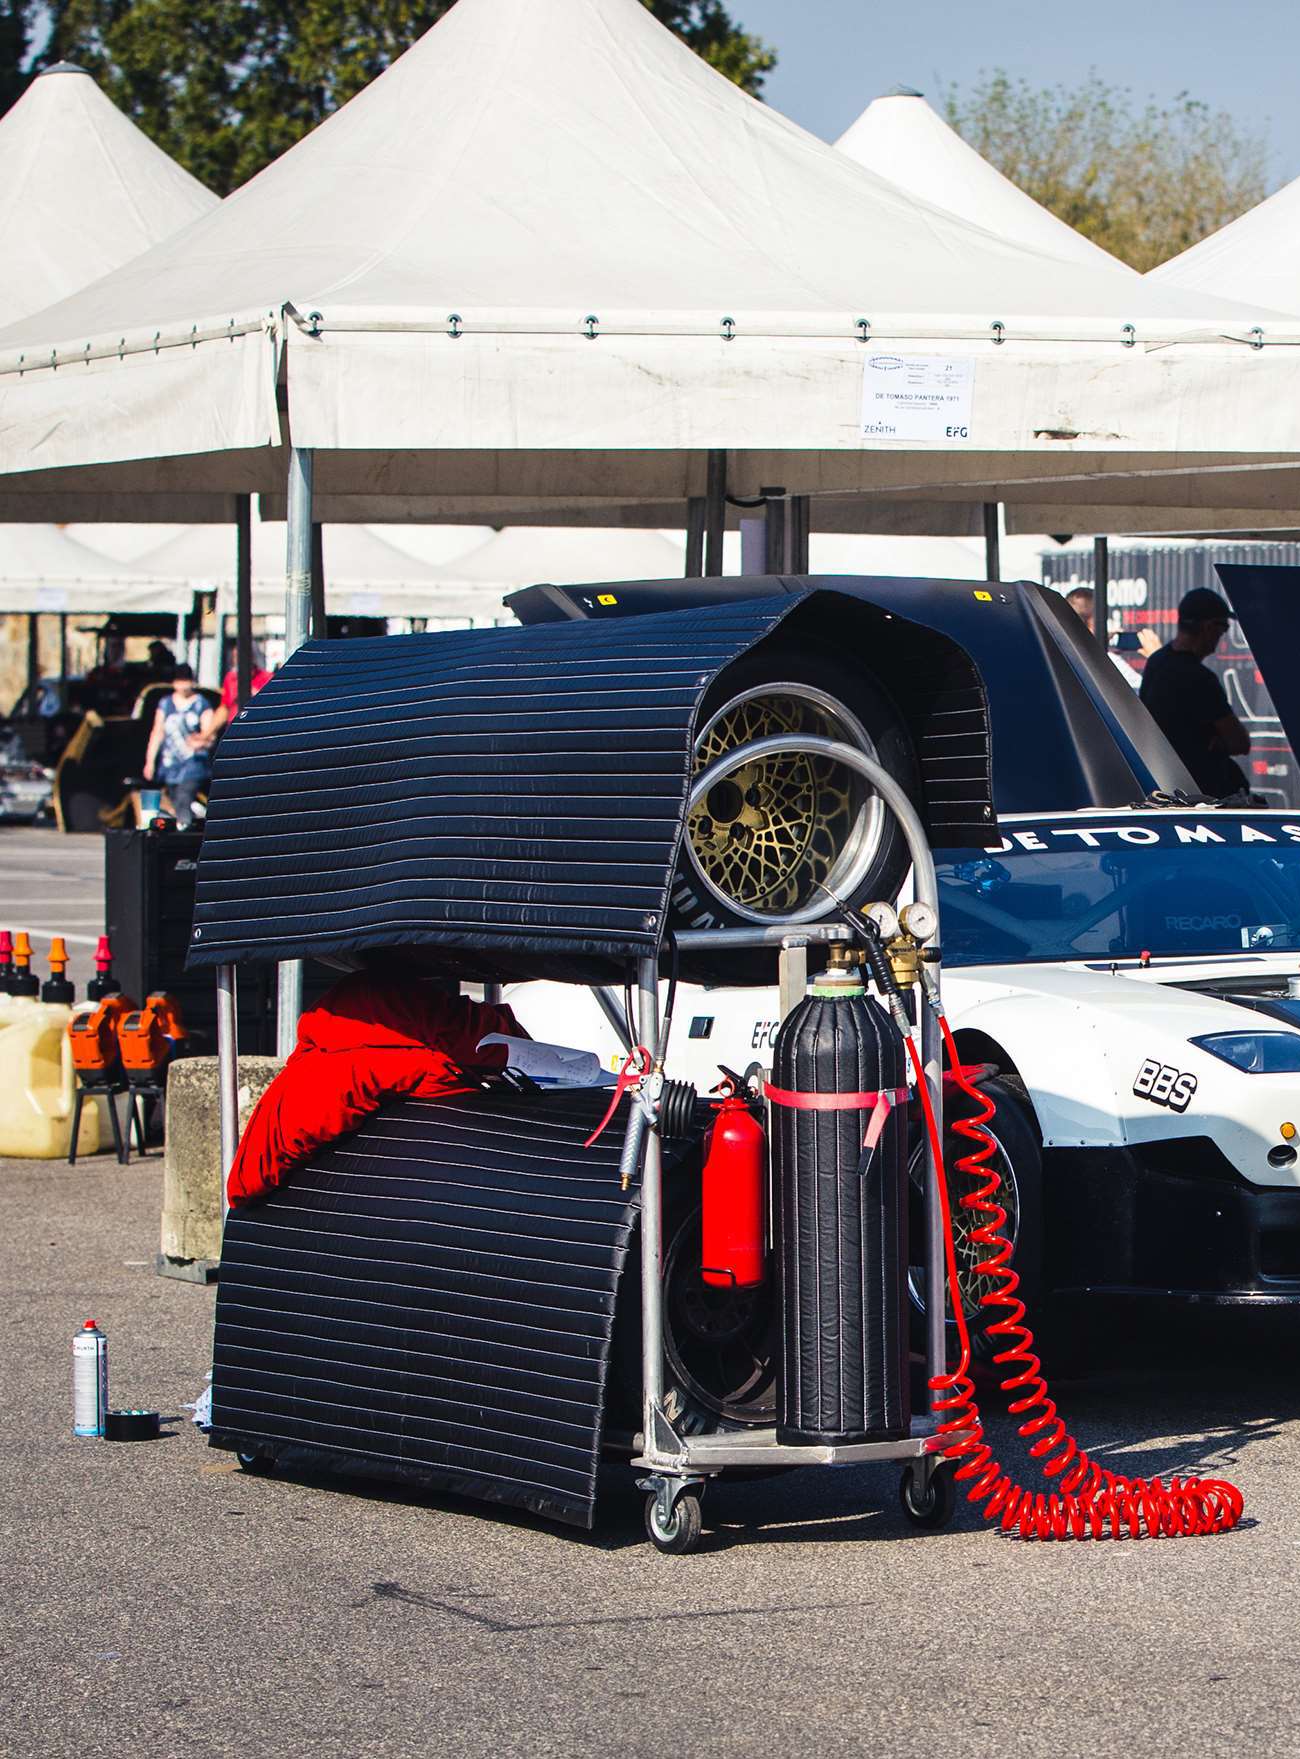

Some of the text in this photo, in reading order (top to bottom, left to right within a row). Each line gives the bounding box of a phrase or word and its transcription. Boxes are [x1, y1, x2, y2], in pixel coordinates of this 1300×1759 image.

[875, 392, 884, 400] DE
[864, 425, 896, 434] ZENITH
[946, 426, 968, 438] EFG
[1164, 914, 1242, 931] RECARO
[1132, 1058, 1198, 1114] BBS
